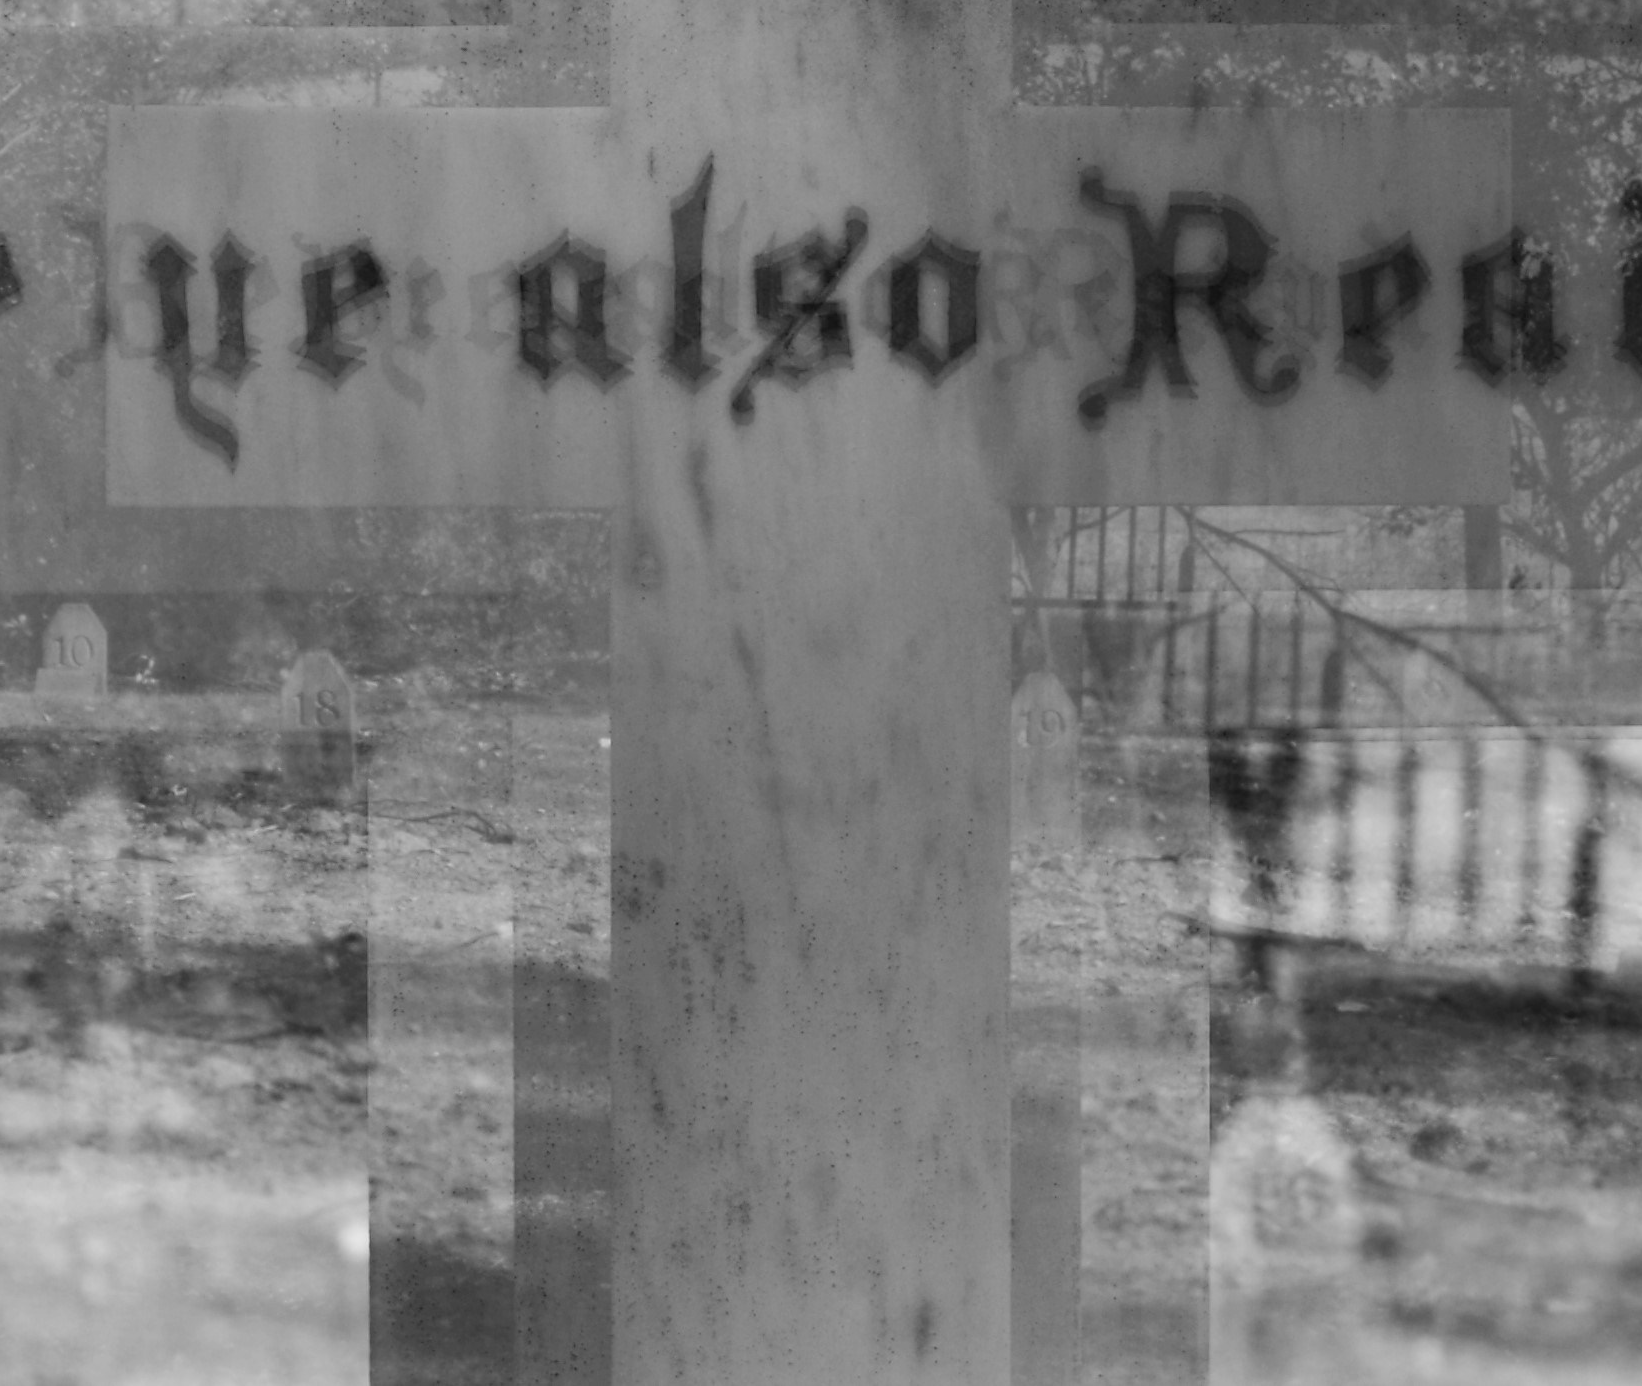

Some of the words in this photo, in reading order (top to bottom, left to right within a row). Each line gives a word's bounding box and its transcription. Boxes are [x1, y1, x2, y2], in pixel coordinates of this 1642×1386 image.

[147, 226, 391, 475] ye
[517, 151, 979, 426] also
[54, 634, 94, 667] 10
[295, 689, 341, 727] 18
